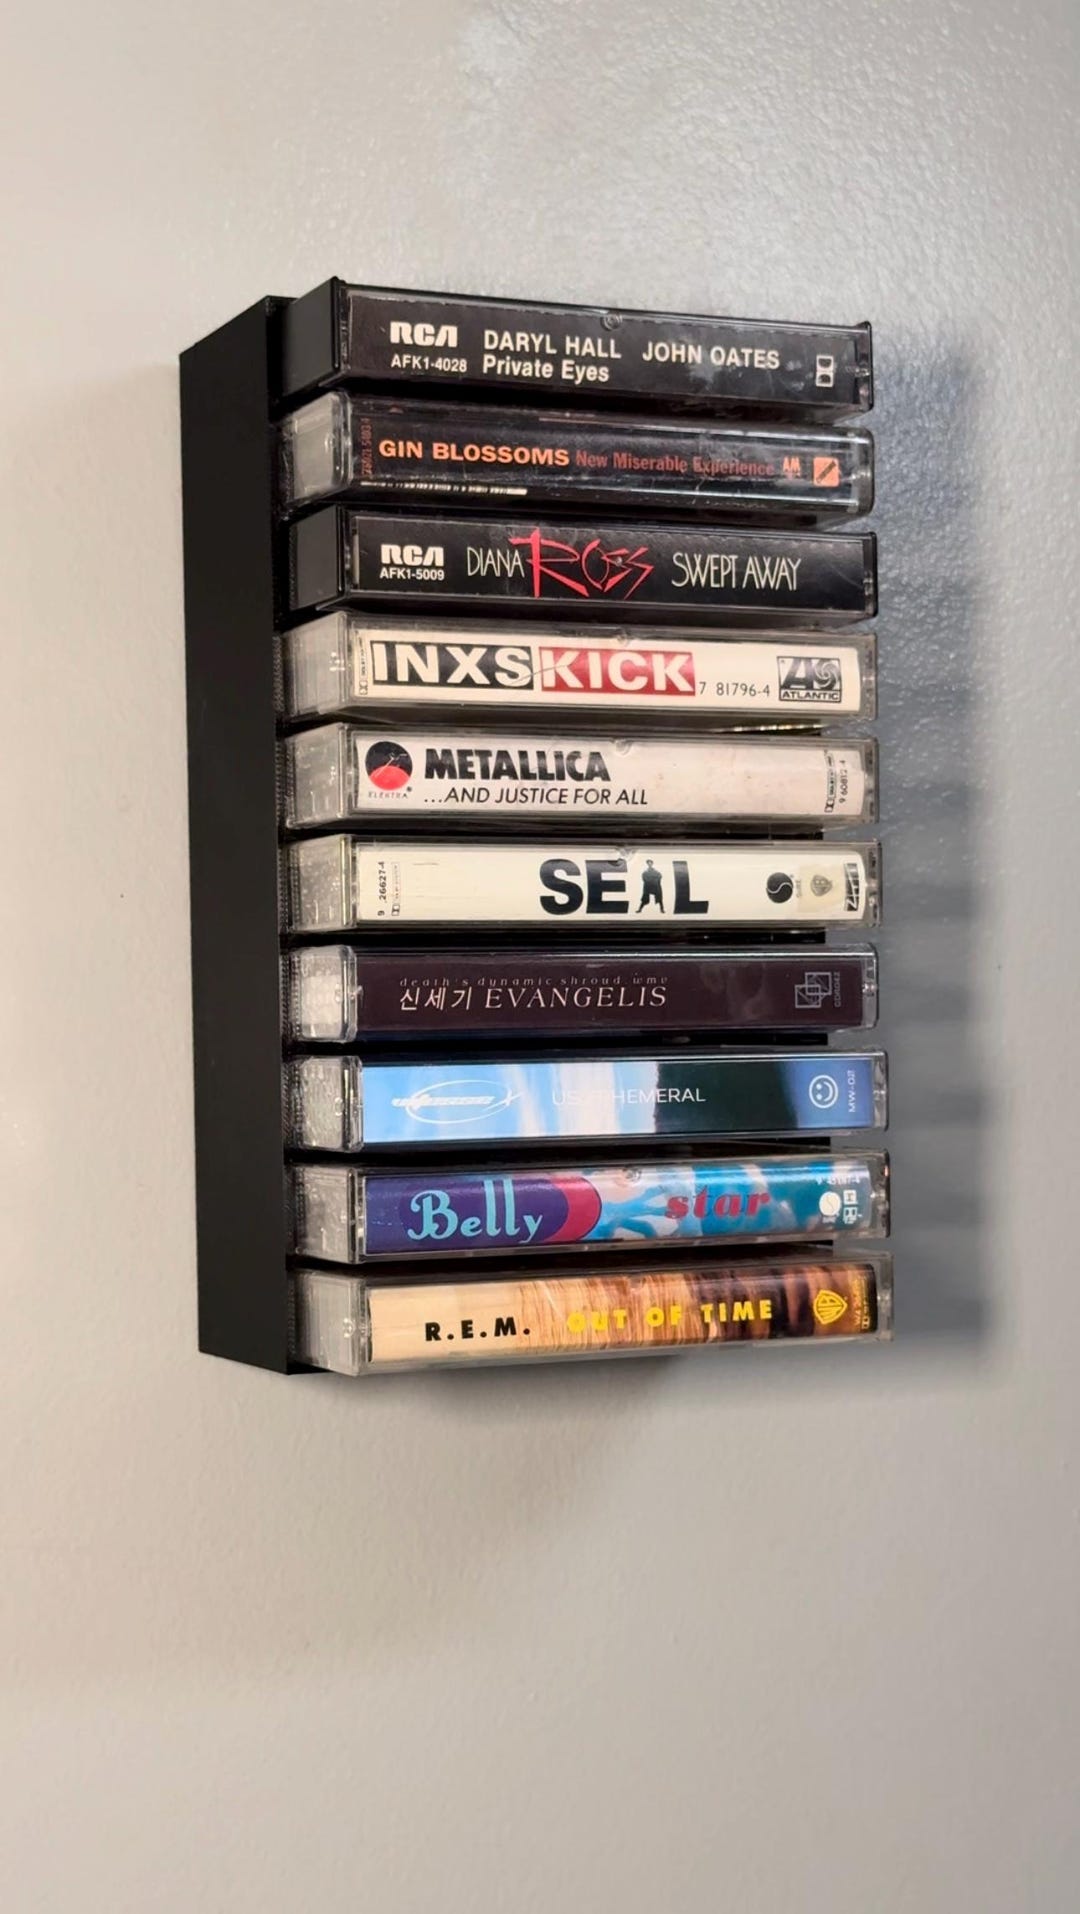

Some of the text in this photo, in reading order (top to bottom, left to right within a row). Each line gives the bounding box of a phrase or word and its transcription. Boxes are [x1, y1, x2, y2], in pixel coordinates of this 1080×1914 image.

[389, 321, 458, 348] RCA
[390, 353, 468, 373] AFK1-4028
[483, 329, 781, 370] DARYL HALL JOHN OATES
[482, 354, 609, 385] Private Eyes
[379, 439, 570, 467] GIN BLOSSOMS
[576, 450, 775, 478] New Miserable Experience
[380, 544, 444, 567] RCA
[466, 527, 655, 600] DIANA ROSS
[379, 567, 445, 581] AFK1-5009
[671, 551, 801, 591] SWEPT AWAY
[372, 642, 533, 688] INXS
[540, 649, 694, 693] KICK
[699, 681, 770, 697] 7 81796-4
[782, 691, 839, 701] ATLANTIC
[424, 748, 612, 782] METALLICA
[423, 786, 649, 805] ...AND JUSTICE FOR ALL
[477, 977, 552, 988] dynamic
[400, 986, 473, 1011] 신세기
[484, 986, 668, 1009] EVANGELIS
[407, 1179, 543, 1244] Belly
[665, 1187, 770, 1220] star
[425, 1317, 530, 1341] R.E.M.
[566, 1299, 772, 1333] OUT OF TIME
